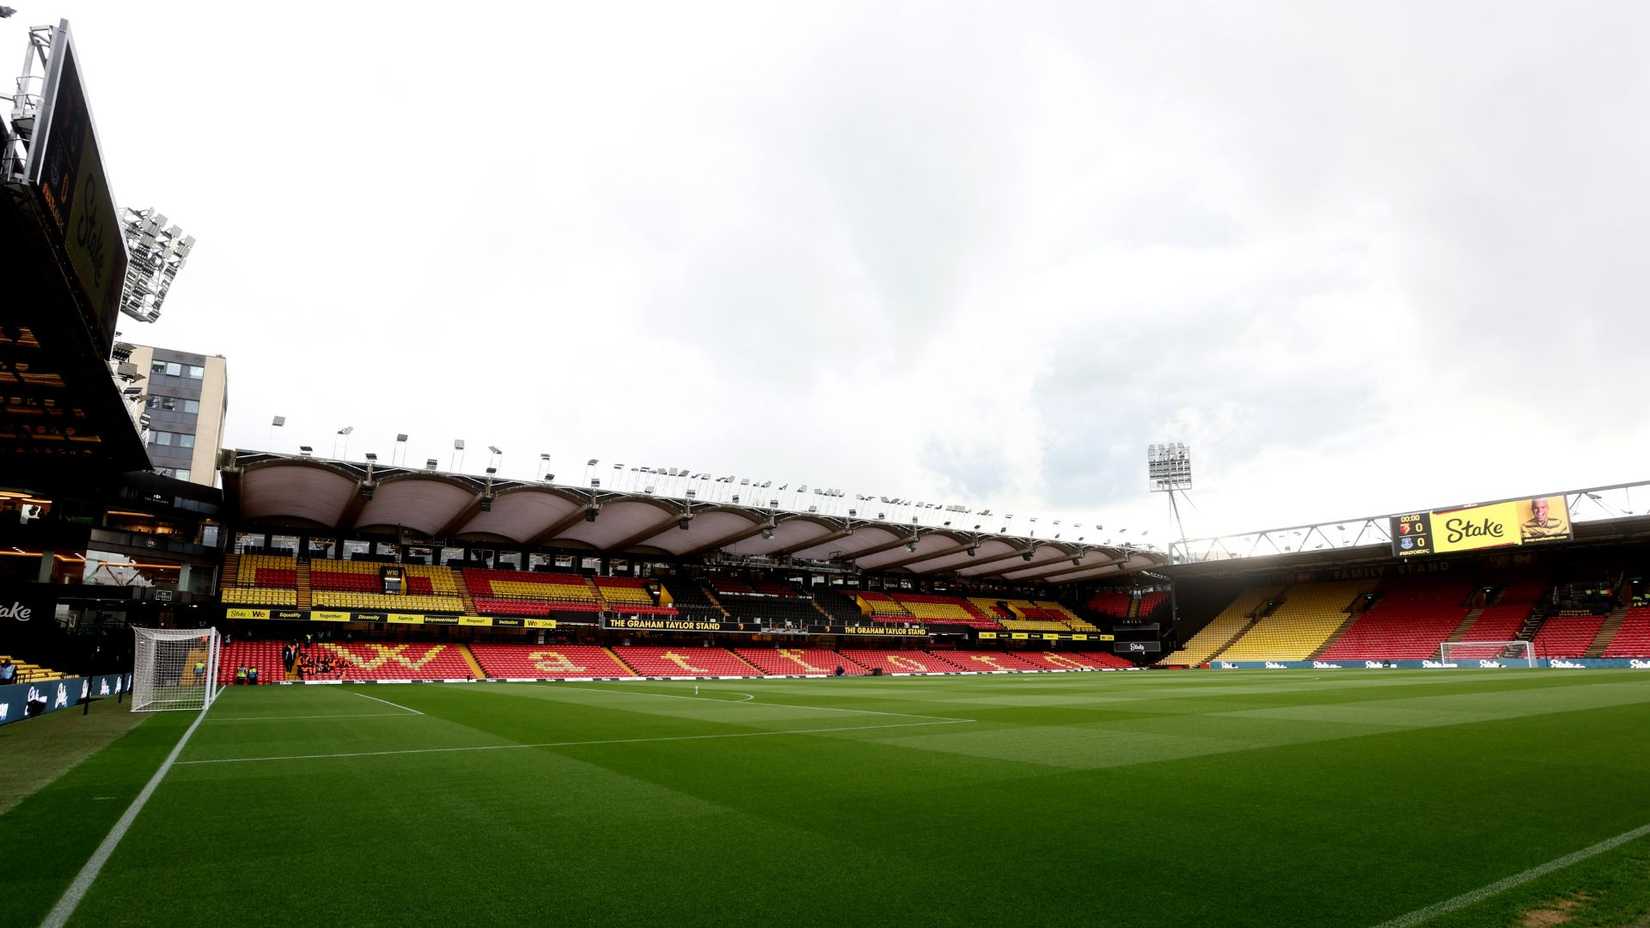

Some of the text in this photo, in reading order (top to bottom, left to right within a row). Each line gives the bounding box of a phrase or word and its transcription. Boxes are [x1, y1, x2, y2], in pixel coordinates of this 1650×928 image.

[1400, 515, 1421, 523] 00:00
[1415, 522, 1423, 532] 0
[1446, 518, 1504, 543] Stake
[1417, 537, 1425, 547] 0
[0, 601, 32, 622] ake
[610, 619, 720, 630] THE GRAHAM TAYLOR STAND
[845, 626, 856, 634] THE
[885, 627, 907, 635] TAYLOR
[908, 628, 926, 636] STAND
